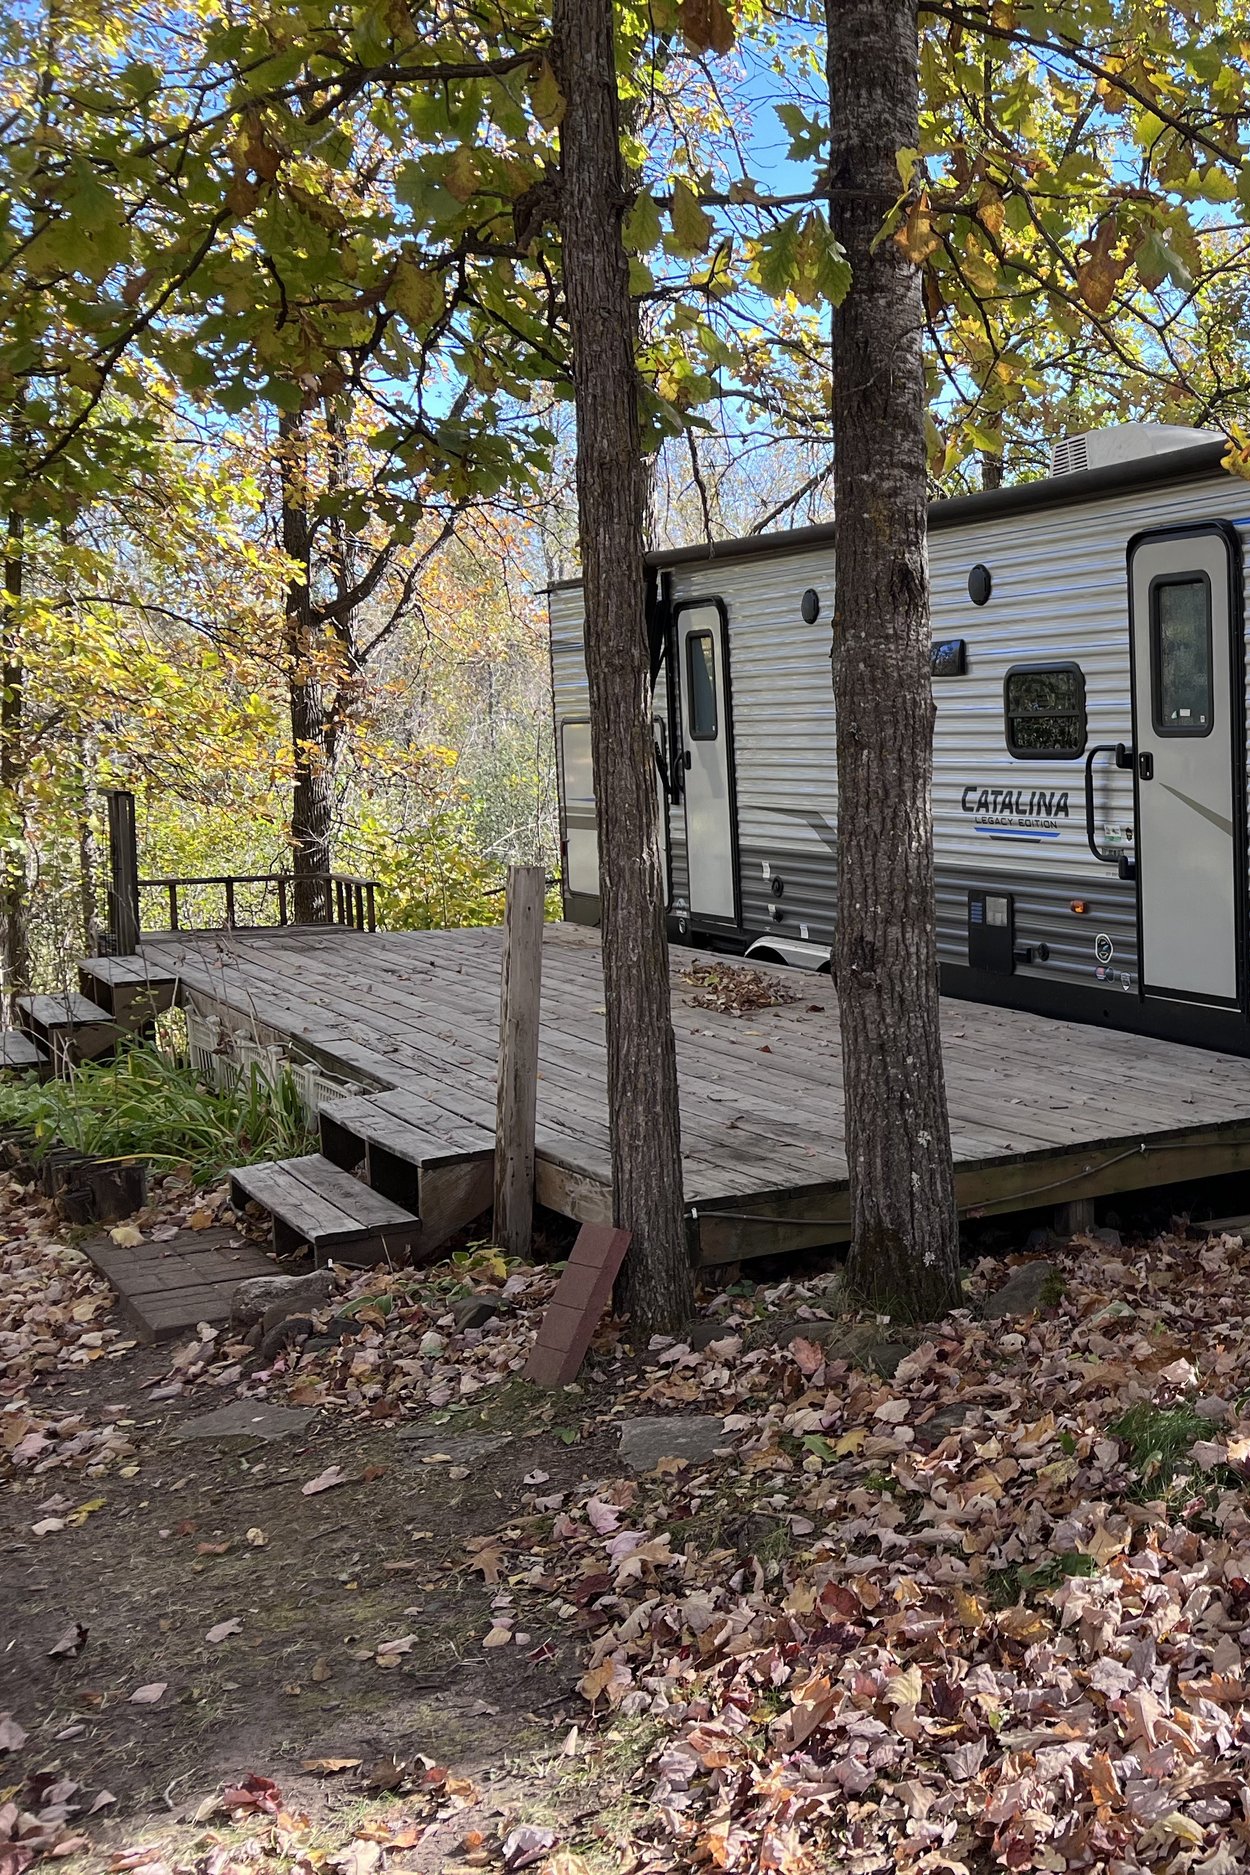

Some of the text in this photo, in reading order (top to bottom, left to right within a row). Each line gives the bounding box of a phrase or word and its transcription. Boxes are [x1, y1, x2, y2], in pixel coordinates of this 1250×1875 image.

[962, 786, 1069, 817] CATALINA
[975, 816, 1058, 829] LEGACY EDITION
